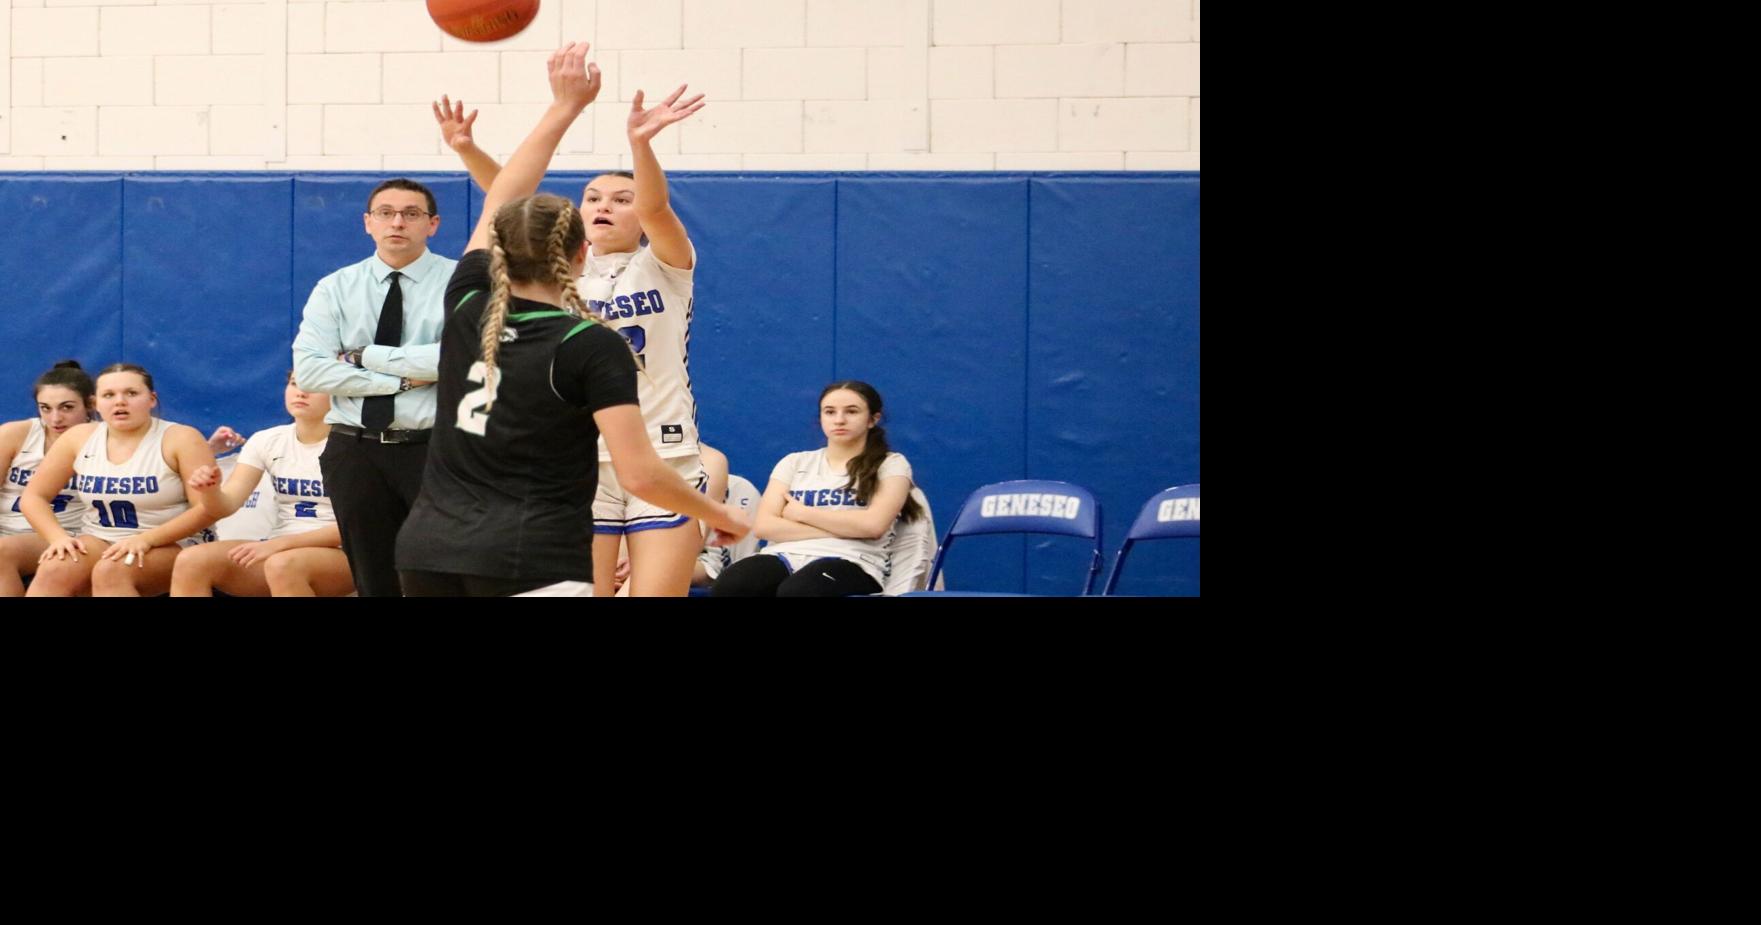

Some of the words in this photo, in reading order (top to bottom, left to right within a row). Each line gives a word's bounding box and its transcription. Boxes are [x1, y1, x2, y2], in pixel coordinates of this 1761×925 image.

[454, 361, 502, 437] 2
[91, 499, 139, 529] 10
[981, 493, 1081, 520] GENESEO
